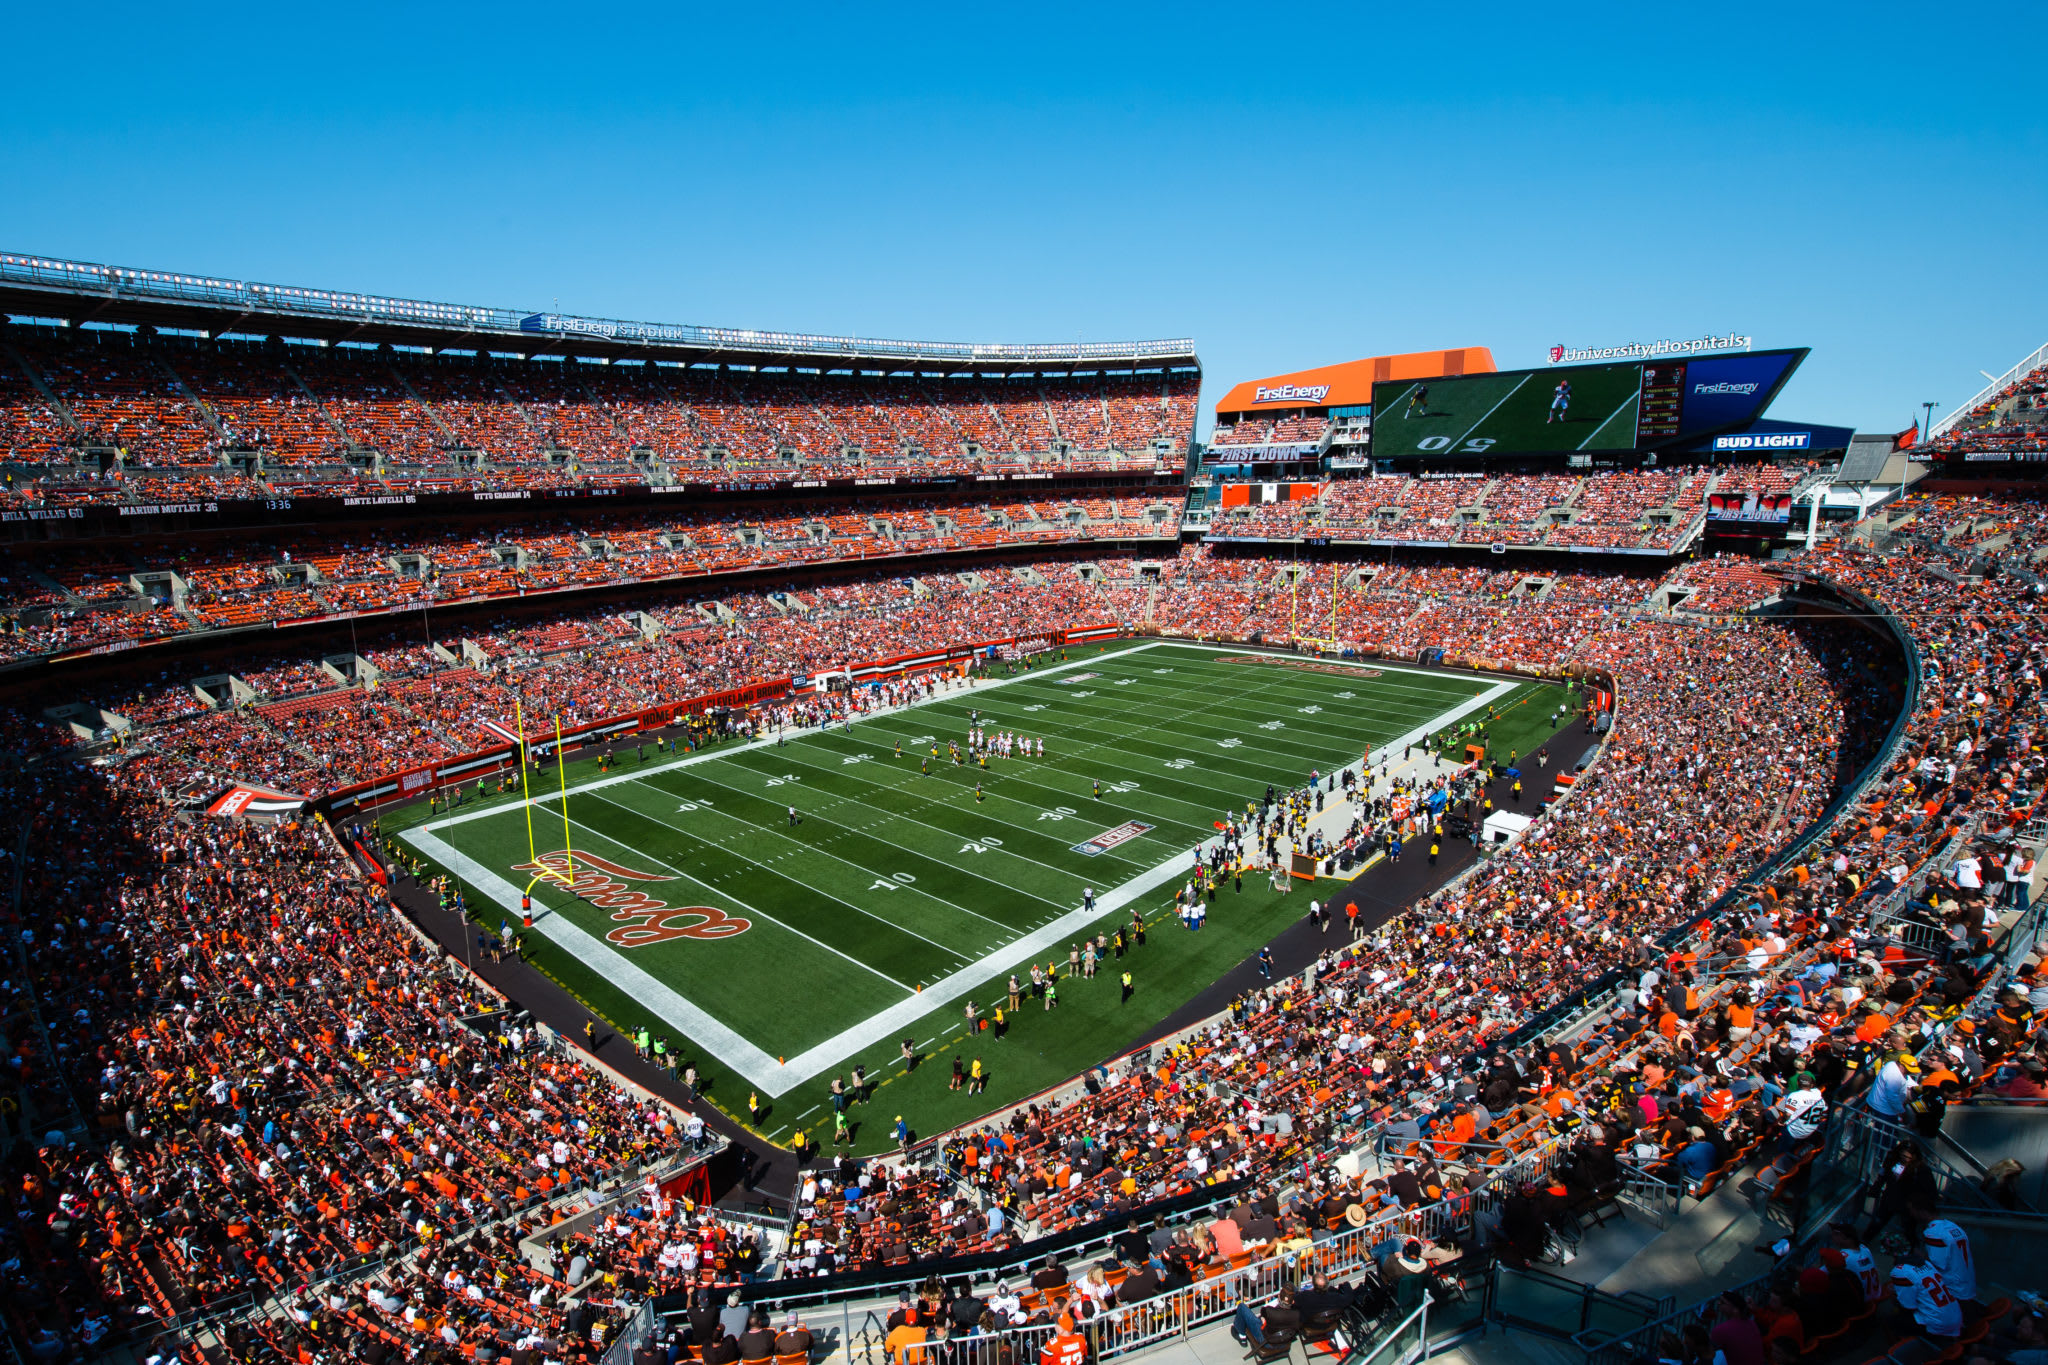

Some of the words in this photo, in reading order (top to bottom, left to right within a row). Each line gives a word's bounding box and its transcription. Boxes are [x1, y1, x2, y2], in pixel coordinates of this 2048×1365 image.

[547, 317, 617, 336] FirstEnergy
[620, 325, 682, 339] STADIUM
[1564, 342, 1652, 361] University
[1656, 333, 1744, 354] Hospitals
[1255, 384, 1330, 400] FirstEnergy
[1694, 382, 1759, 394] FirstEnergy
[1716, 437, 1752, 448] BUD
[1754, 435, 1806, 447] LIGHT
[1220, 448, 1256, 461] FIRST
[1259, 446, 1300, 461] DOWN
[266, 501, 291, 509] 13:36
[344, 498, 372, 506] DANTE
[373, 496, 404, 504] LAVELLI
[1, 512, 27, 521] BILL
[29, 510, 66, 520] WILLIS
[68, 508, 84, 518] 60
[119, 506, 160, 516] MARION
[205, 502, 218, 512] 36
[1716, 508, 1746, 519] FIRST
[1746, 510, 1780, 520] DOWN
[90, 645, 107, 655] FIRST
[110, 640, 139, 652] DOWN
[643, 711, 670, 726] HOME
[688, 701, 706, 714] THE
[706, 690, 754, 708] CLEVELAND
[756, 682, 791, 698] BROWNS
[1164, 758, 1196, 770] 50
[403, 769, 431, 782] CLEVELAND
[767, 774, 800, 786] 20
[404, 776, 432, 791] BROWNS
[1110, 781, 1140, 793] 40
[680, 799, 714, 812] 10
[1043, 806, 1077, 821] 30
[1095, 824, 1142, 845] KICKOFF
[968, 837, 1003, 854] 20
[877, 872, 916, 891] 10
[511, 850, 752, 948] Browns
[1800, 1108, 1824, 1124] 42
